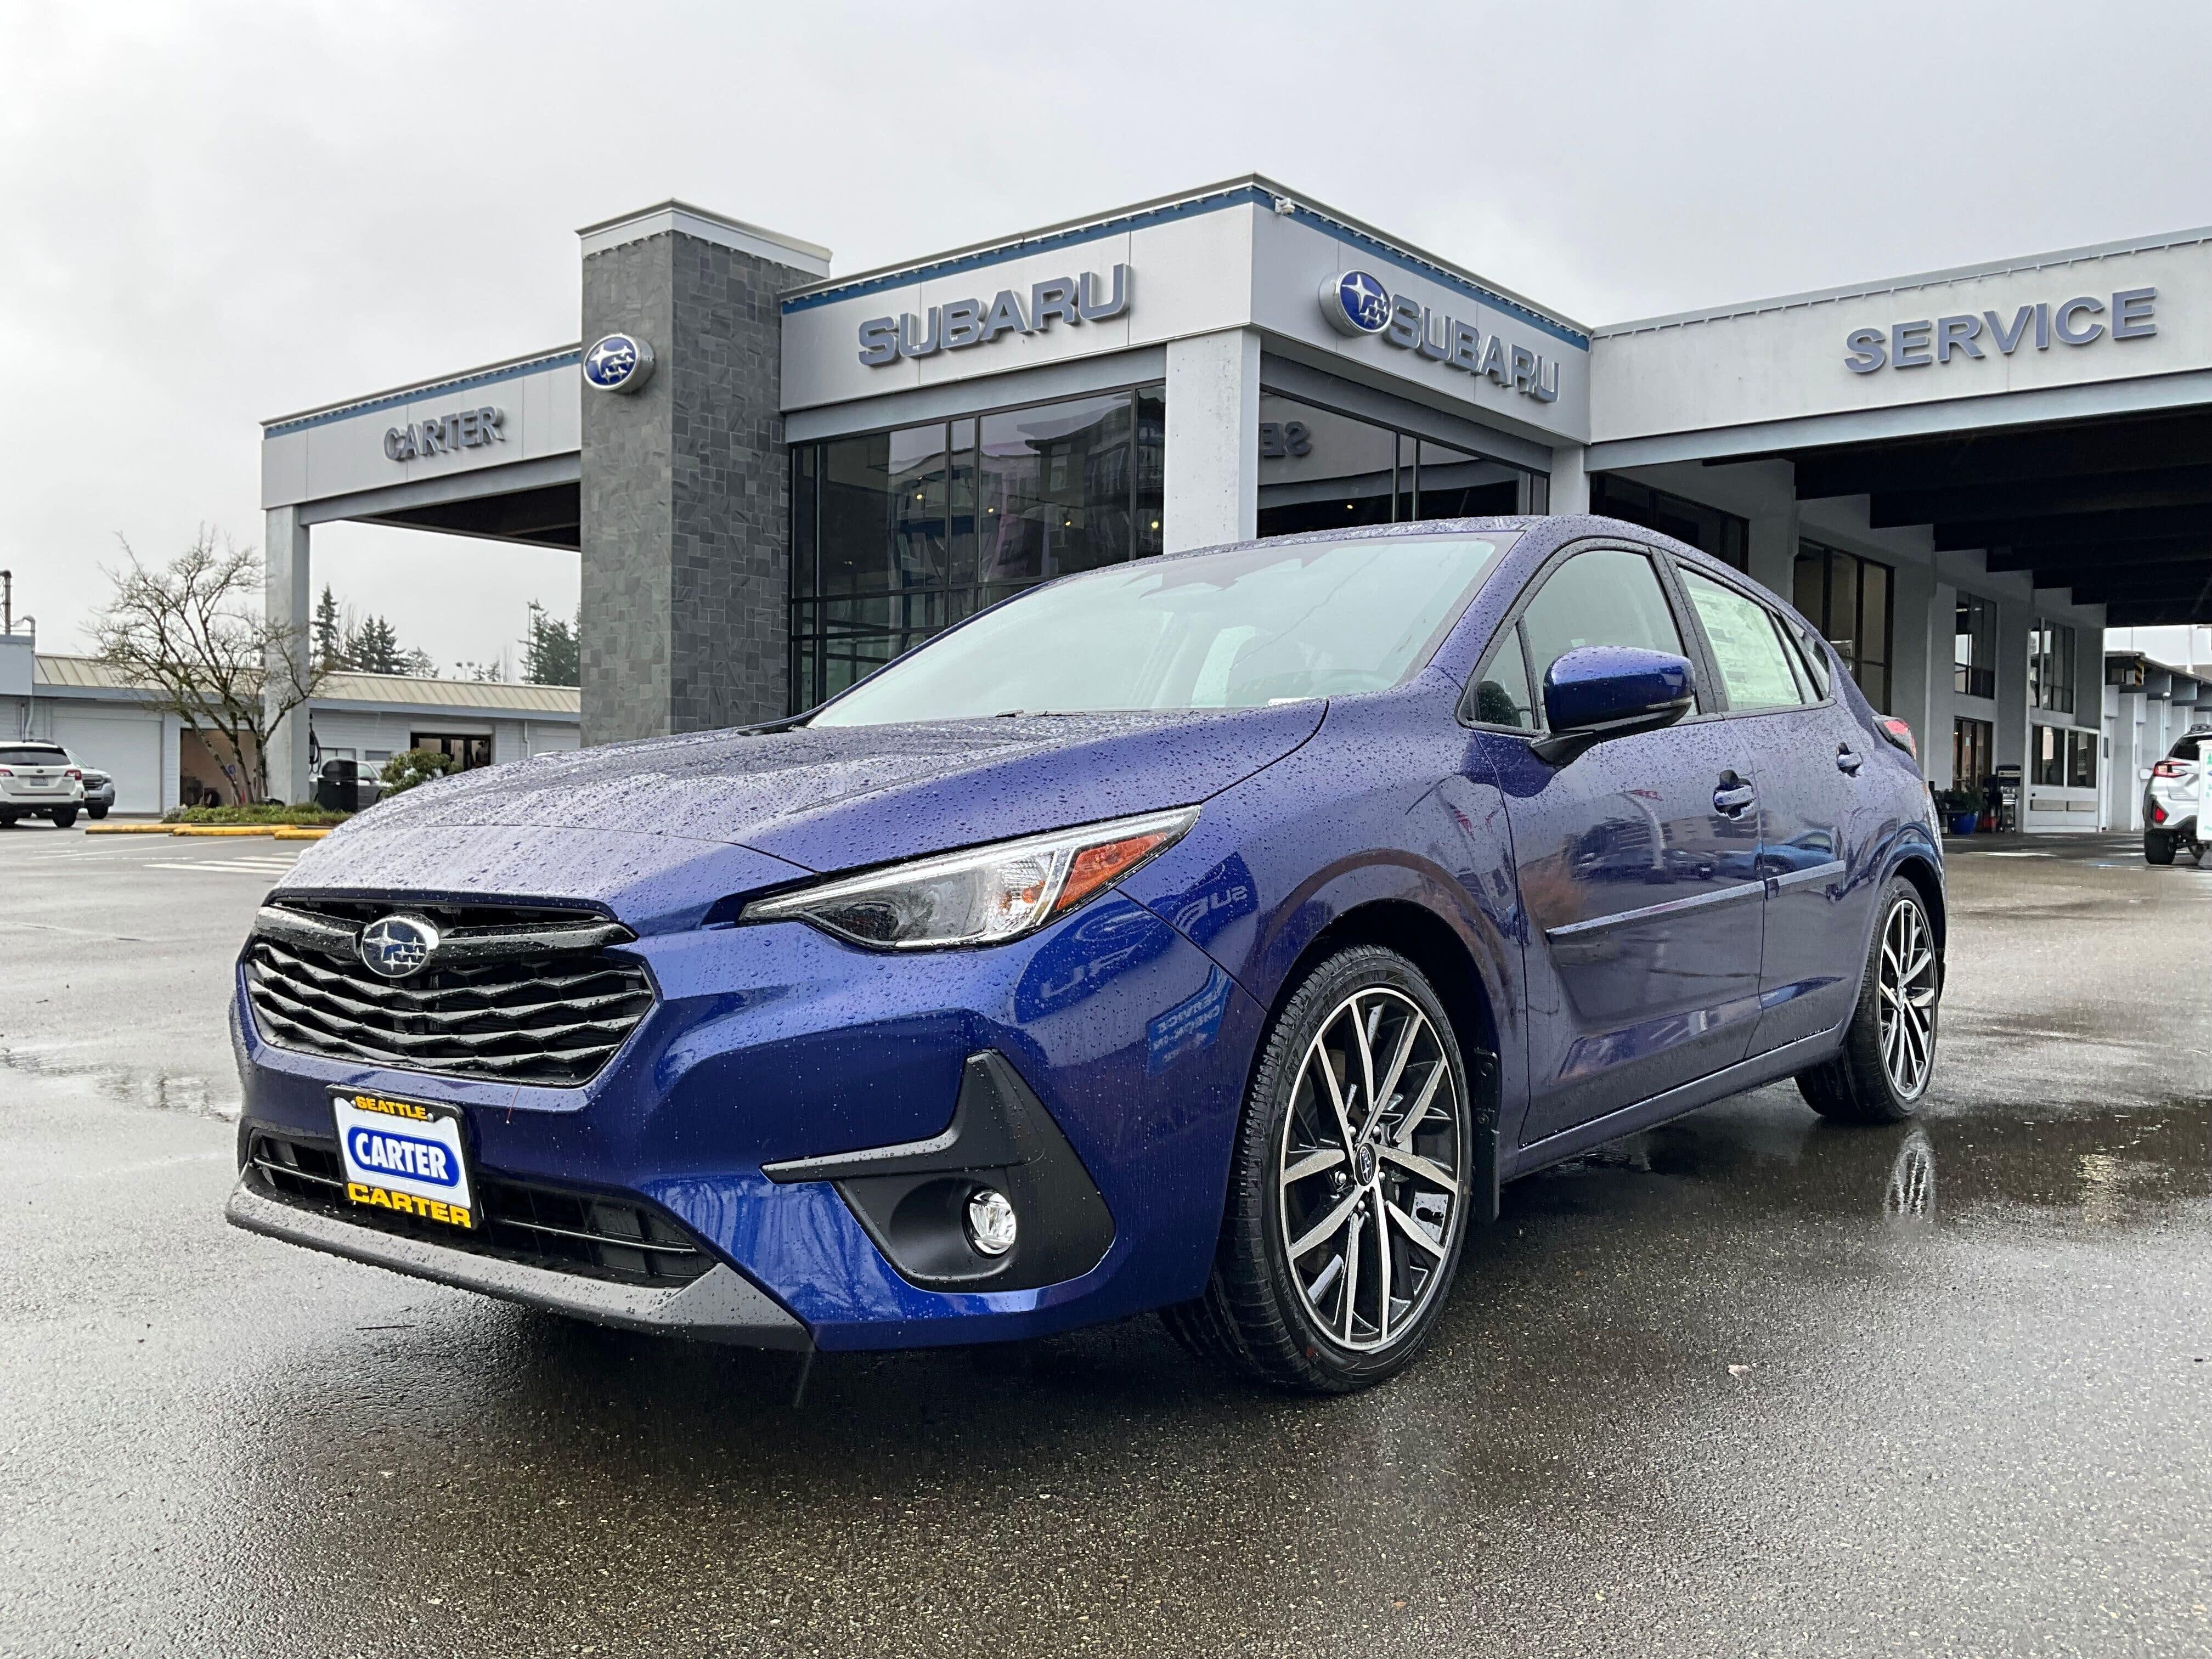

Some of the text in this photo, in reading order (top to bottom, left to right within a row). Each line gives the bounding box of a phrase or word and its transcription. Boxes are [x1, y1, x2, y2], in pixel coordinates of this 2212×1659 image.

[858, 263, 1131, 366] SUBARU
[1844, 286, 2157, 374] SERVICE
[1386, 294, 1560, 403] SUBARU
[384, 406, 504, 461] CARTER
[355, 1096, 428, 1120] SEATTLE
[356, 1132, 449, 1180] CARTER
[347, 1182, 471, 1228] CARTER
